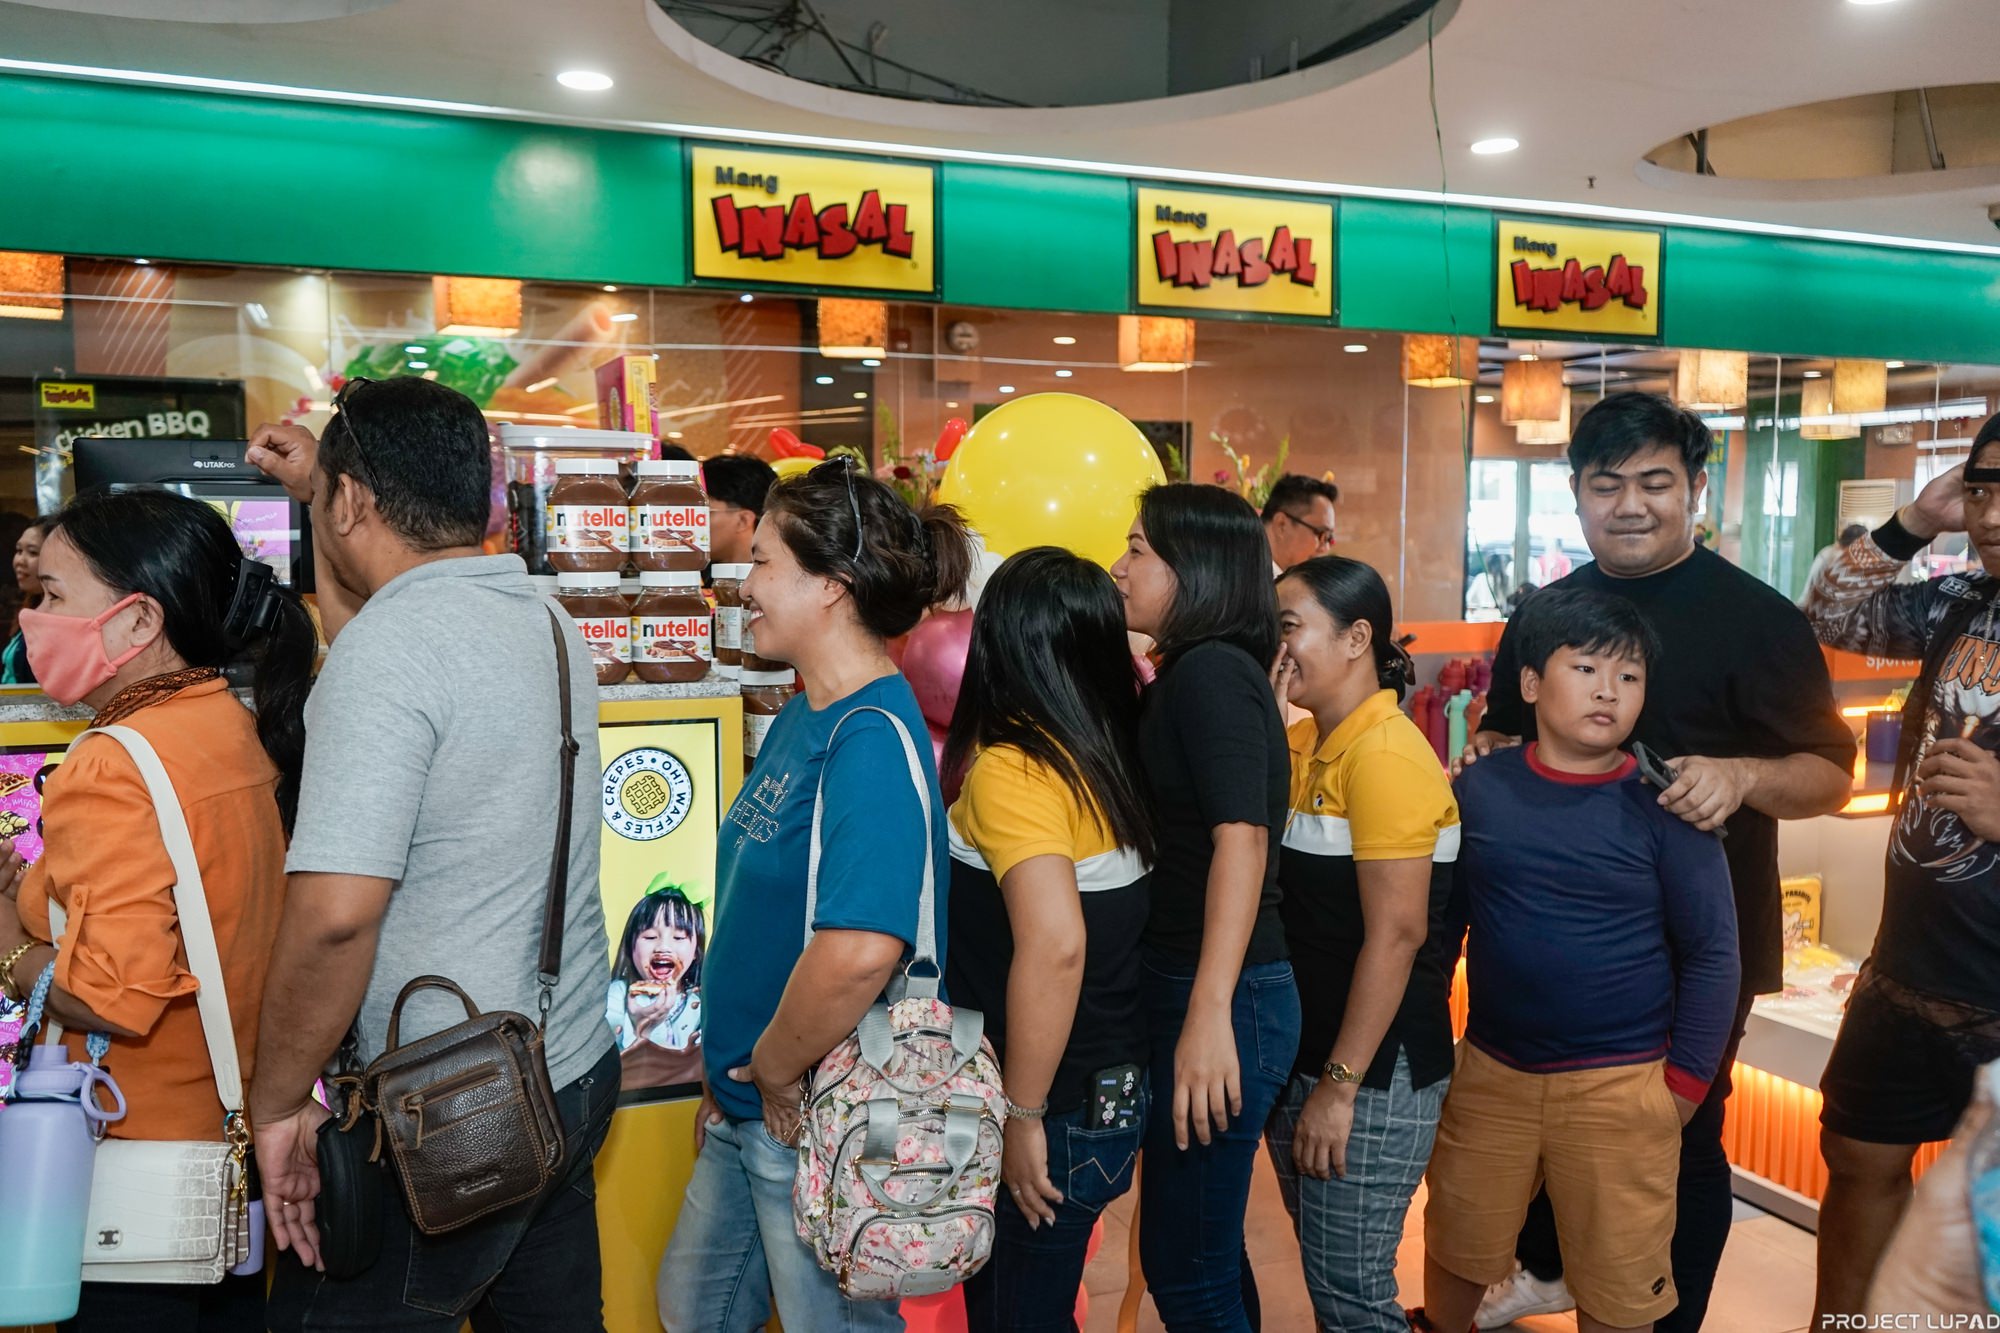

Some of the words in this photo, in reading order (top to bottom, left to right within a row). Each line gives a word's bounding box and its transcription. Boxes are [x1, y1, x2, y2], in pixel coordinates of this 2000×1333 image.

[715, 165, 778, 194] Mang
[710, 189, 914, 262] INASAL
[1155, 204, 1208, 229] Mang
[1151, 225, 1317, 290] INASAL
[1513, 235, 1557, 258] Mang
[1510, 254, 1648, 314] INASAL
[147, 410, 210, 438] BBQ
[640, 508, 707, 527] nutella
[578, 620, 628, 638] tella
[642, 618, 709, 637] nutella
[604, 755, 645, 806] CREPES
[661, 760, 684, 786] OH!
[611, 811, 622, 821] &
[623, 791, 687, 834] WAFFLES
